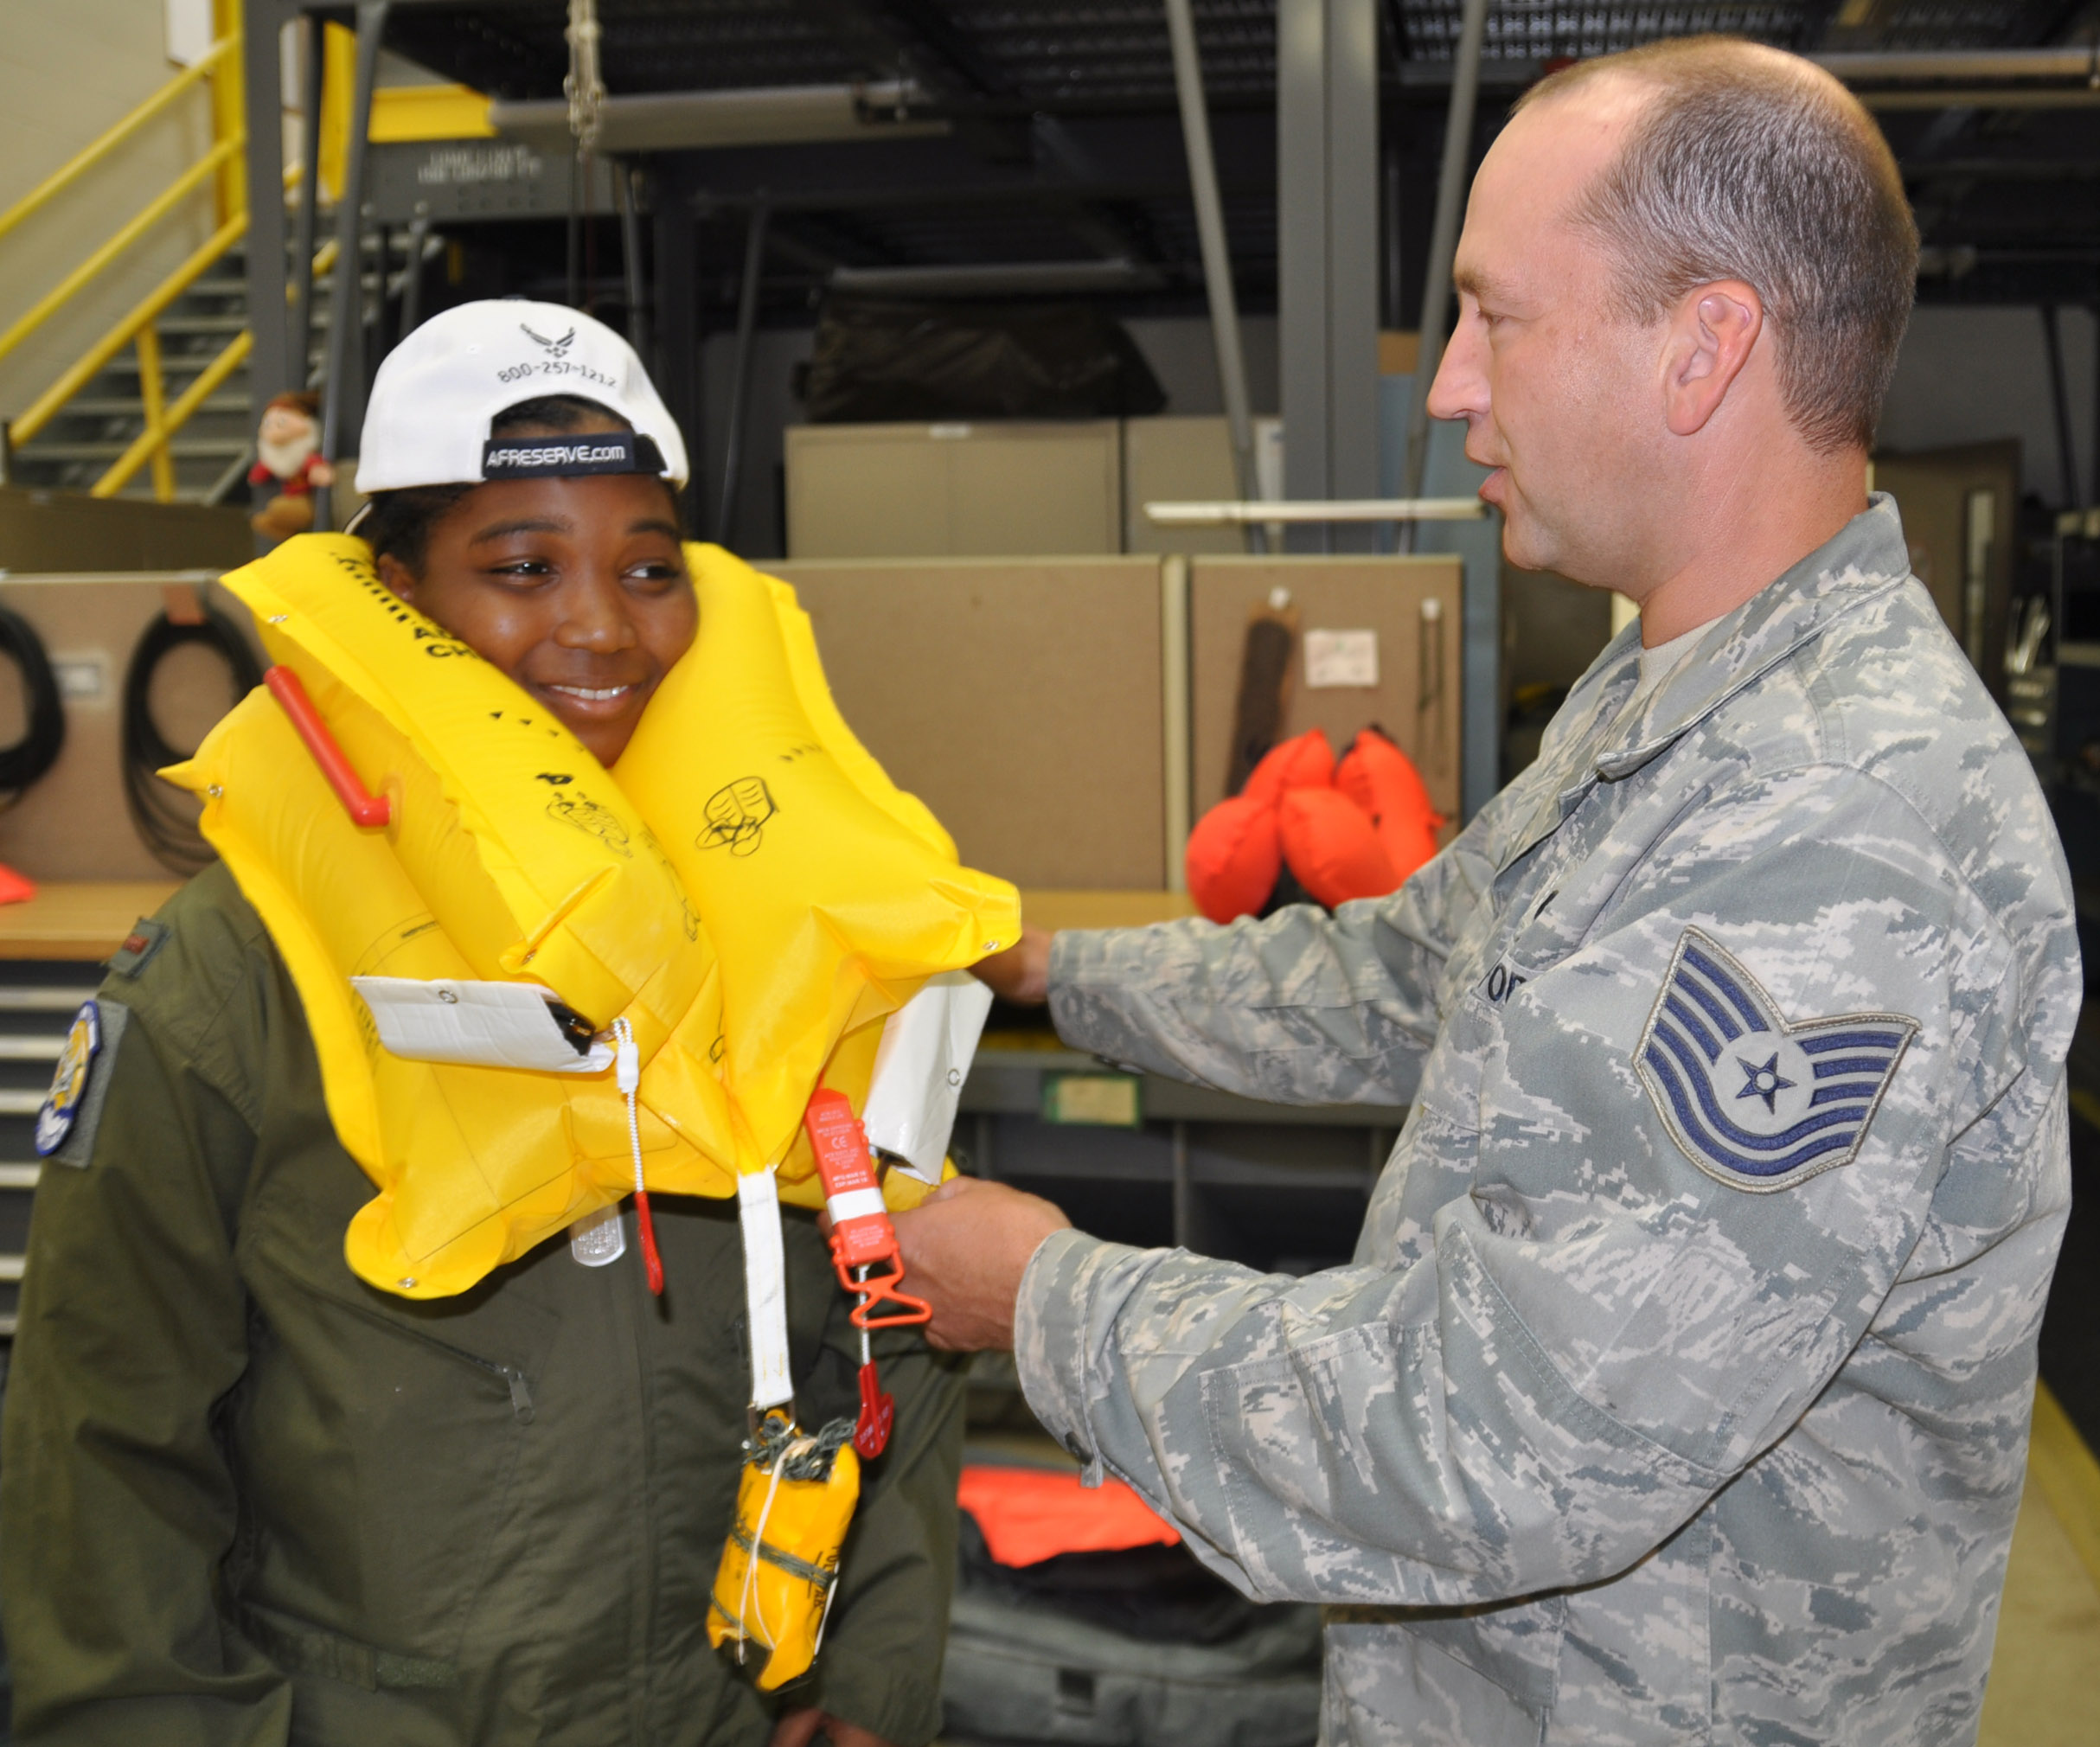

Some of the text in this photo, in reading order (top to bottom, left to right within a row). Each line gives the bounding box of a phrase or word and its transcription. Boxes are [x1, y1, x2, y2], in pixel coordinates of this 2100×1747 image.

[497, 362, 617, 388] 800-257-1212
[485, 444, 627, 468] AFRESERVE.com
[831, 1136, 848, 1149] CE
